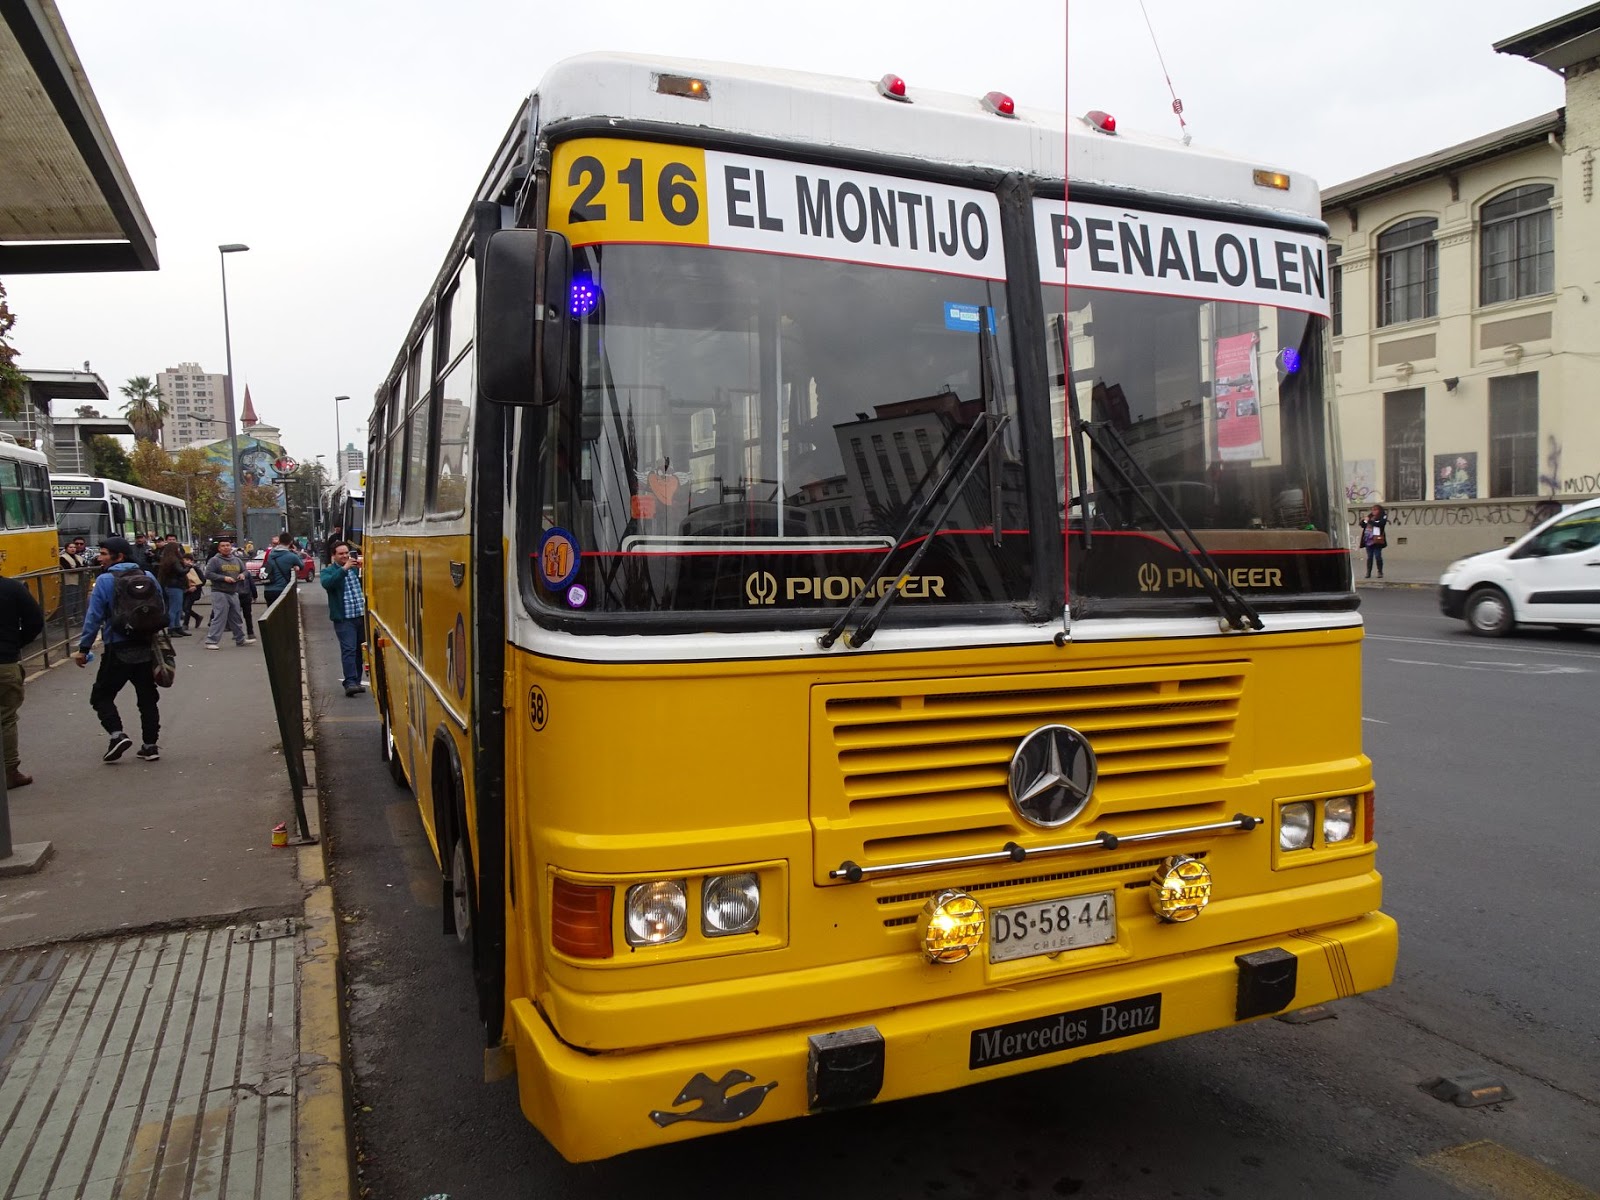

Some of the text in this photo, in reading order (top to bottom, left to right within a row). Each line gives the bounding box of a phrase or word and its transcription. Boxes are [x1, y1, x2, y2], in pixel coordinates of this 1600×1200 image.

[568, 156, 699, 226] 216
[724, 165, 989, 261] EL MONTIJO
[1050, 213, 1325, 299] PEÑALOLEN
[786, 575, 946, 600] PIONEER
[530, 692, 544, 725] 58
[977, 1005, 1155, 1063] Mercedes Benz
